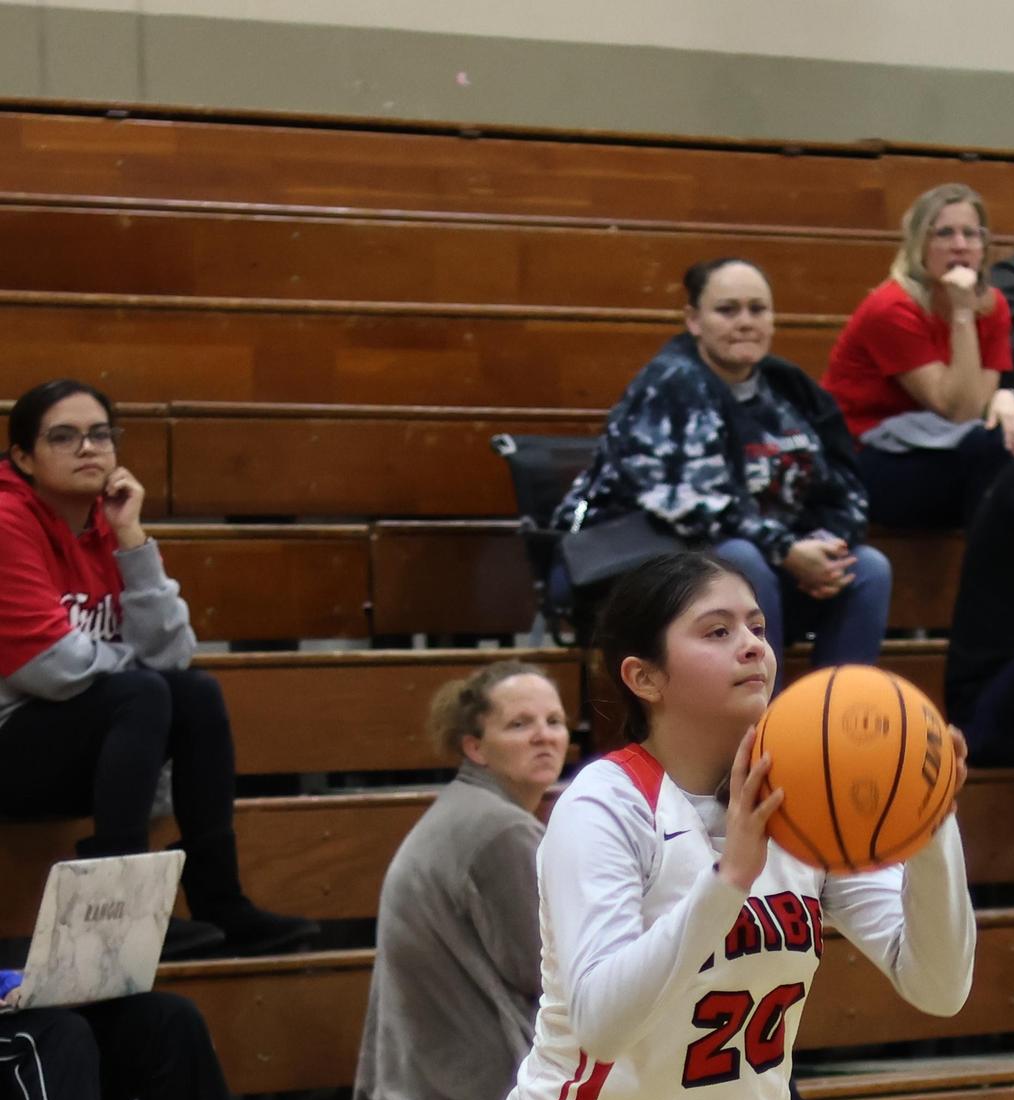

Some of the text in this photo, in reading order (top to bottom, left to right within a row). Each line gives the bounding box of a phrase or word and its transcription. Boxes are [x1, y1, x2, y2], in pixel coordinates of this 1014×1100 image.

[60, 593, 120, 640] Trib
[698, 890, 823, 973] RIBE
[682, 981, 805, 1089] 20
